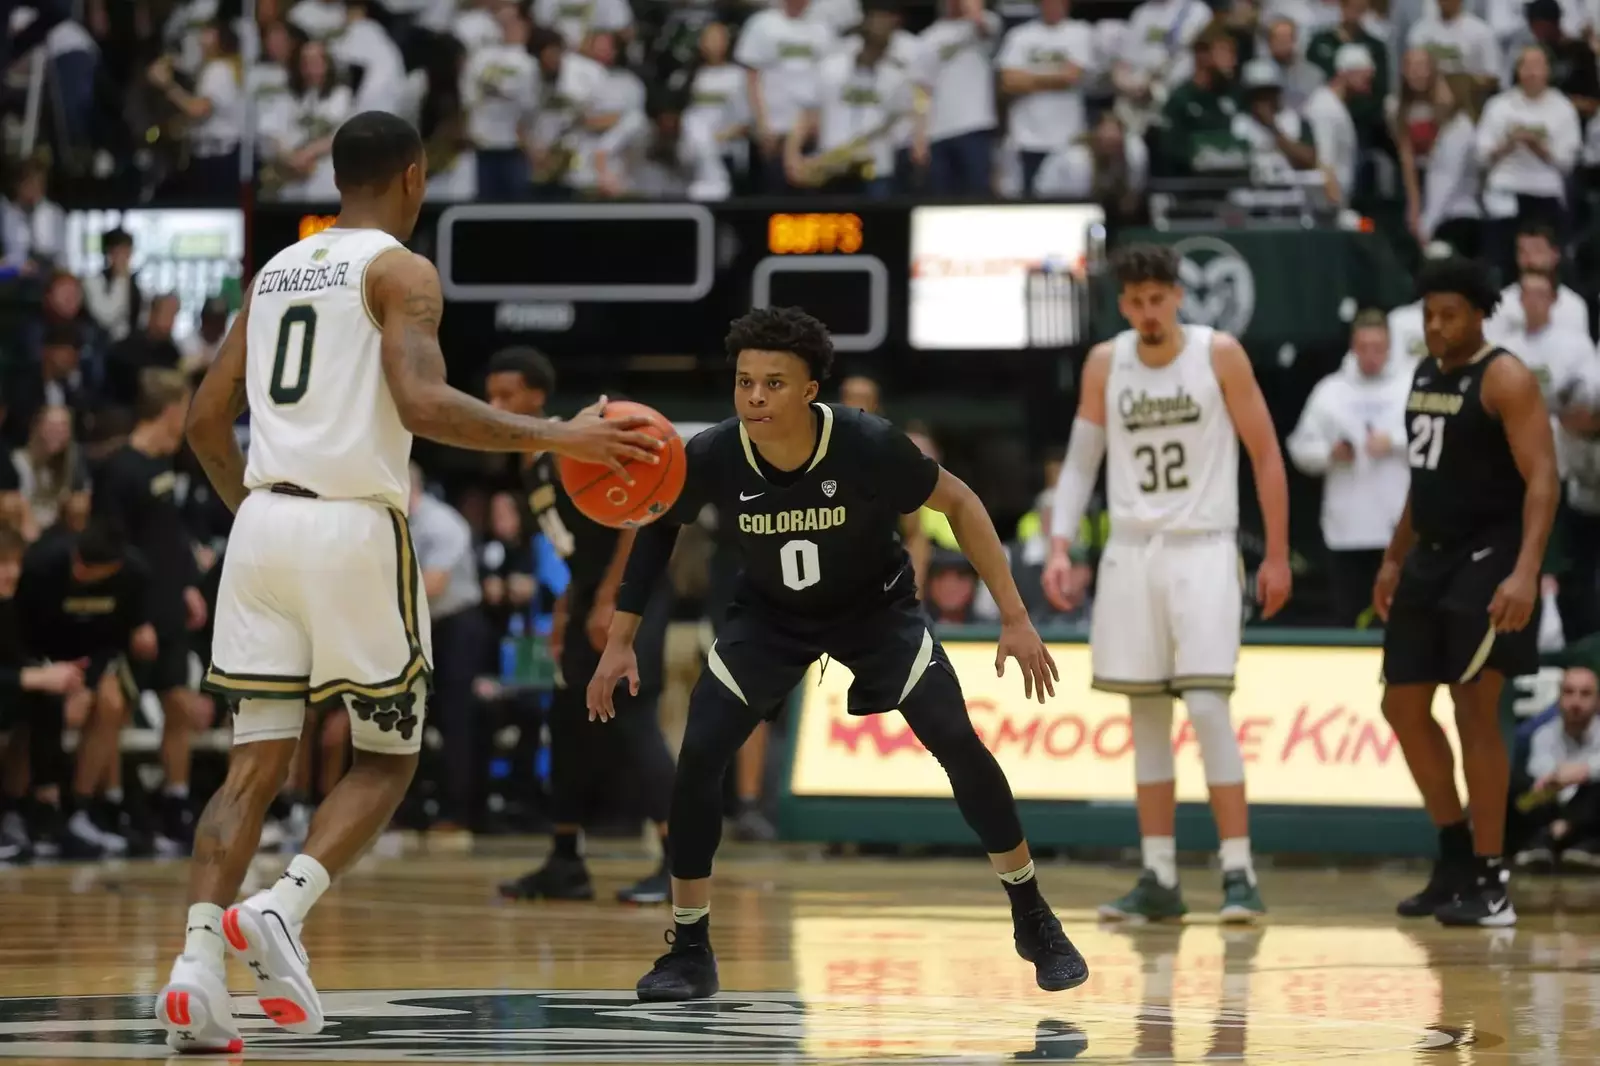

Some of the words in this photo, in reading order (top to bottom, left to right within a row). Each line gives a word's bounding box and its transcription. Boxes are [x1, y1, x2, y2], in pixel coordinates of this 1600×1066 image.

[258, 266, 331, 296] EDWARDS
[327, 261, 349, 287] JR.
[269, 304, 317, 405] 0
[1134, 441, 1189, 493] 32
[1408, 414, 1446, 470] 21
[738, 505, 846, 535] COLORADO
[779, 539, 821, 591] 0
[965, 697, 1273, 762] SMOOHE
[1279, 704, 1399, 764] KiN
